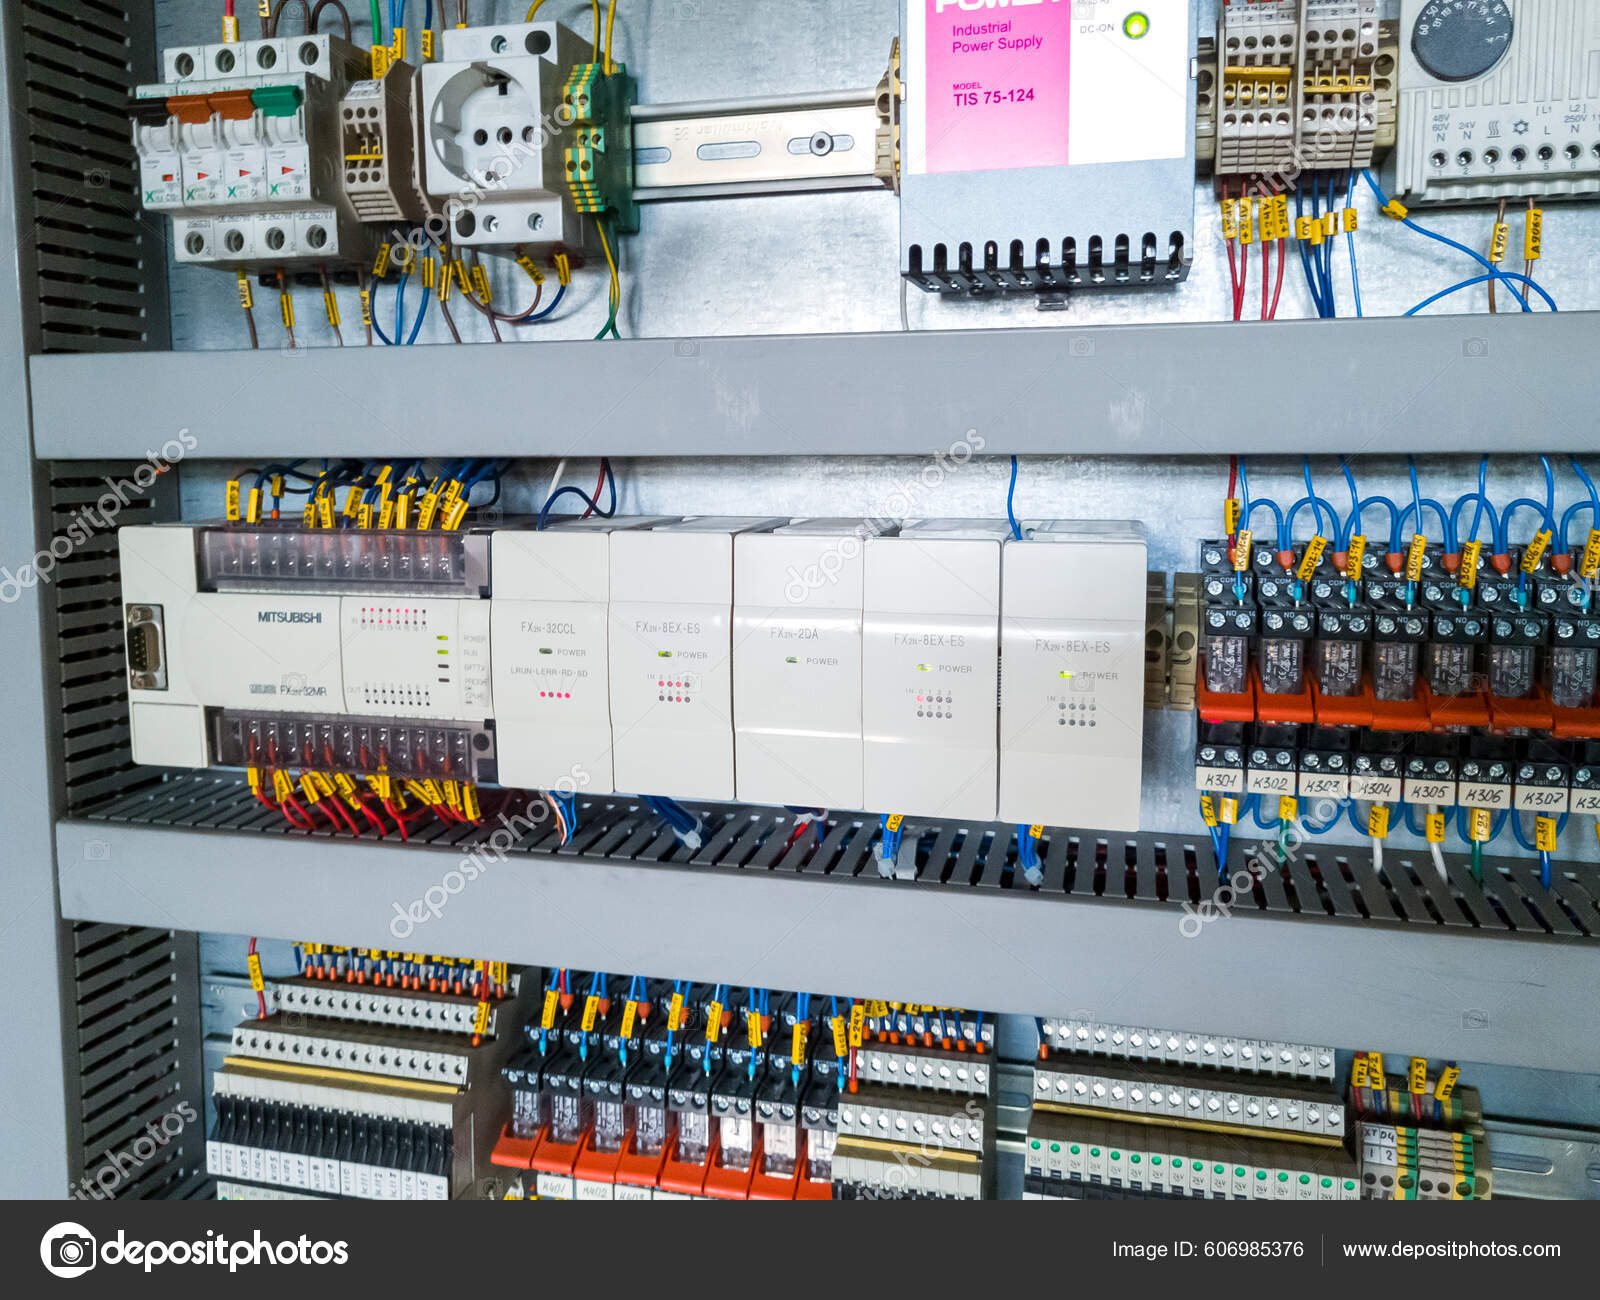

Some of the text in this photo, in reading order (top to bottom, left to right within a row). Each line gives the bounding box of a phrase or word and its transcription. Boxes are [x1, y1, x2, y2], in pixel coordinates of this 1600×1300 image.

[1426, 5, 1439, 17] 50
[953, 21, 1012, 36] Industrial
[1080, 23, 1114, 34] DC-ON
[1418, 24, 1429, 35] 60
[952, 35, 1043, 53] Power Supply
[953, 82, 982, 90] MODEL
[954, 88, 1035, 106] TIS 75-124
[1458, 122, 1475, 130] 24V
[1463, 131, 1472, 140] N
[1544, 126, 1552, 135] L
[1571, 124, 1580, 133] N
[258, 611, 322, 624] MITSUBISHI
[557, 649, 586, 657] POWER
[677, 651, 708, 659] POWER
[806, 657, 838, 665] POWER
[938, 665, 972, 673] POWER
[1082, 672, 1118, 680] POWER
[1253, 777, 1289, 791] K302
[1304, 780, 1341, 793] K303
[1360, 782, 1392, 796] K304
[1411, 786, 1449, 798] K305
[1465, 789, 1504, 803] K306
[1523, 793, 1564, 805] K307
[1386, 1151, 1393, 1161] 2
